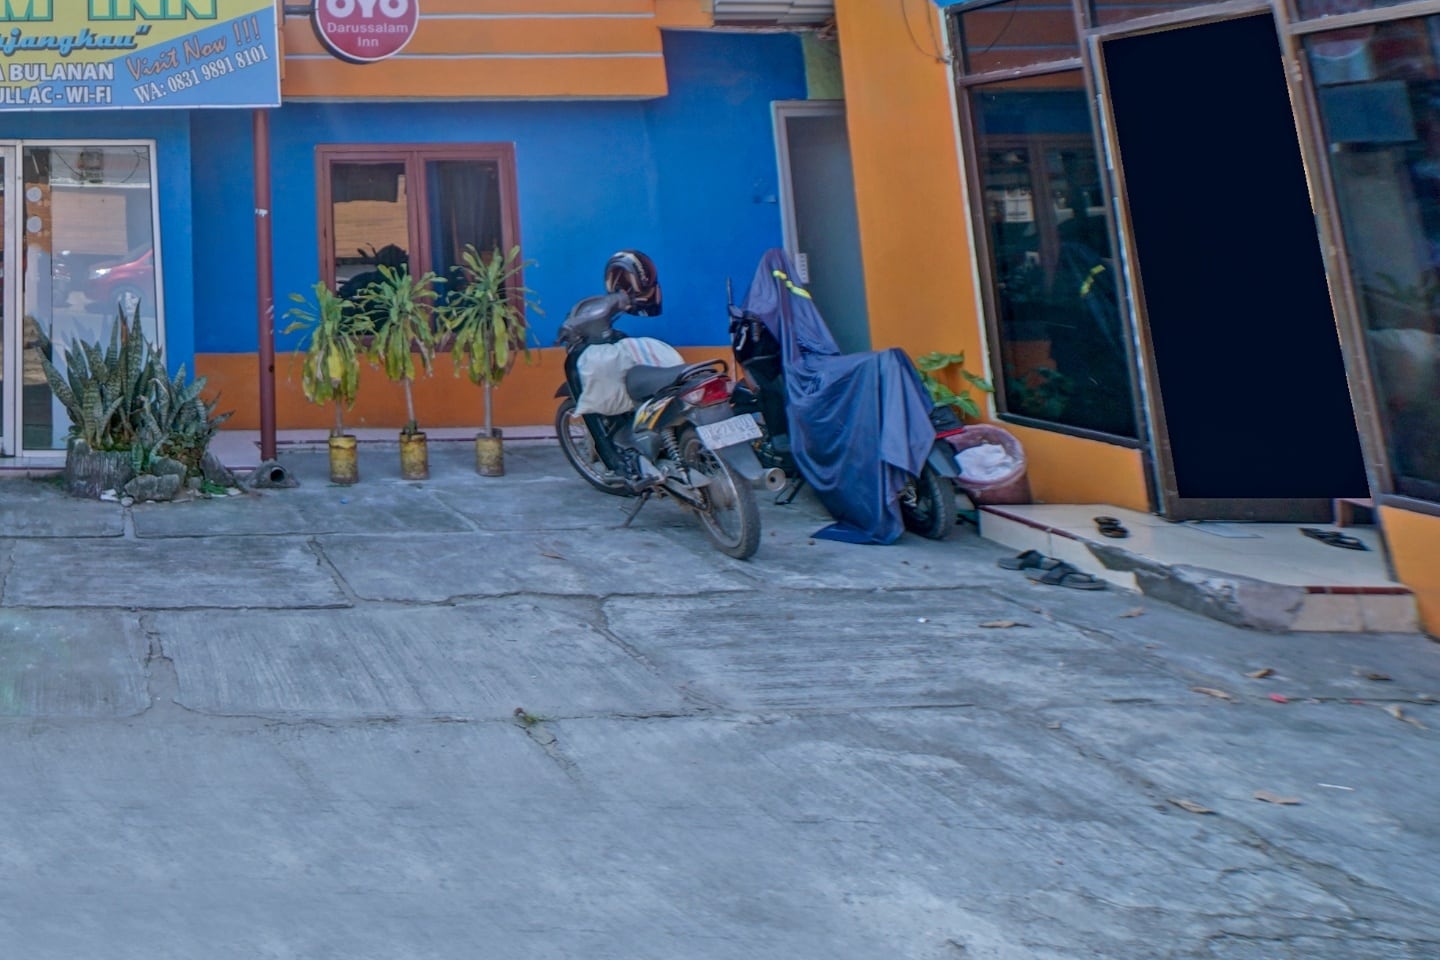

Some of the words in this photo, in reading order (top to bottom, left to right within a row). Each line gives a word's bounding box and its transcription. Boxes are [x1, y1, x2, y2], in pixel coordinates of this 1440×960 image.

[327, 22, 409, 33] Darussalam
[357, 36, 380, 47] Inn
[126, 47, 179, 80] Visit
[183, 34, 227, 65] Now
[9, 62, 114, 82] BULANAN
[133, 81, 167, 104] WA:
[167, 68, 201, 93] 0831
[200, 56, 235, 81] 9891
[235, 44, 269, 69] 8101
[28, 86, 53, 104] AC
[64, 85, 113, 104] WI-FI
